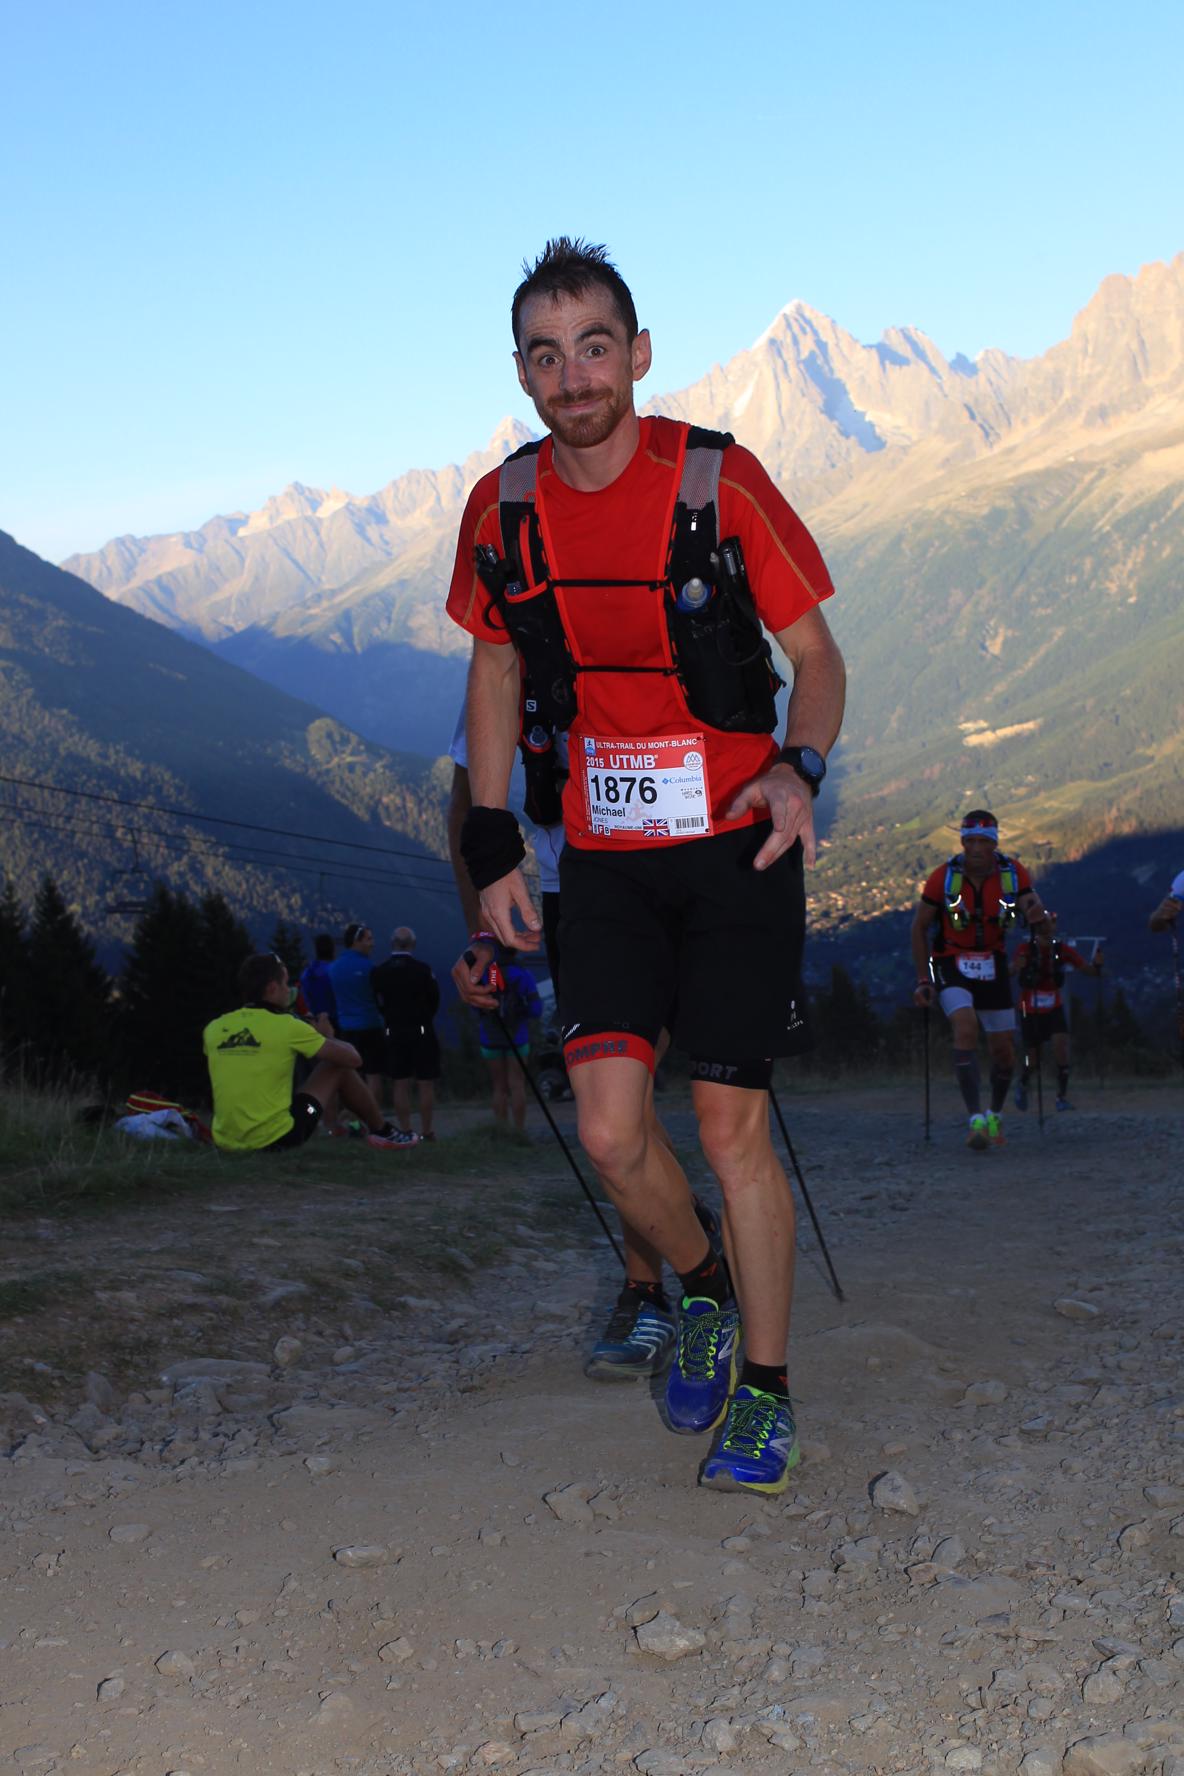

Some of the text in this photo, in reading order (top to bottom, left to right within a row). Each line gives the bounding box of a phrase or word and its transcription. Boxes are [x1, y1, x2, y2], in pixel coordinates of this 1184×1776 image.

[596, 738, 698, 750] ULTRA-TRAIL DU MONT-BLANC
[586, 754, 656, 769] 2015 UTMB
[669, 775, 702, 784] Columbia
[591, 774, 658, 805] 1876
[592, 804, 626, 817] Michael
